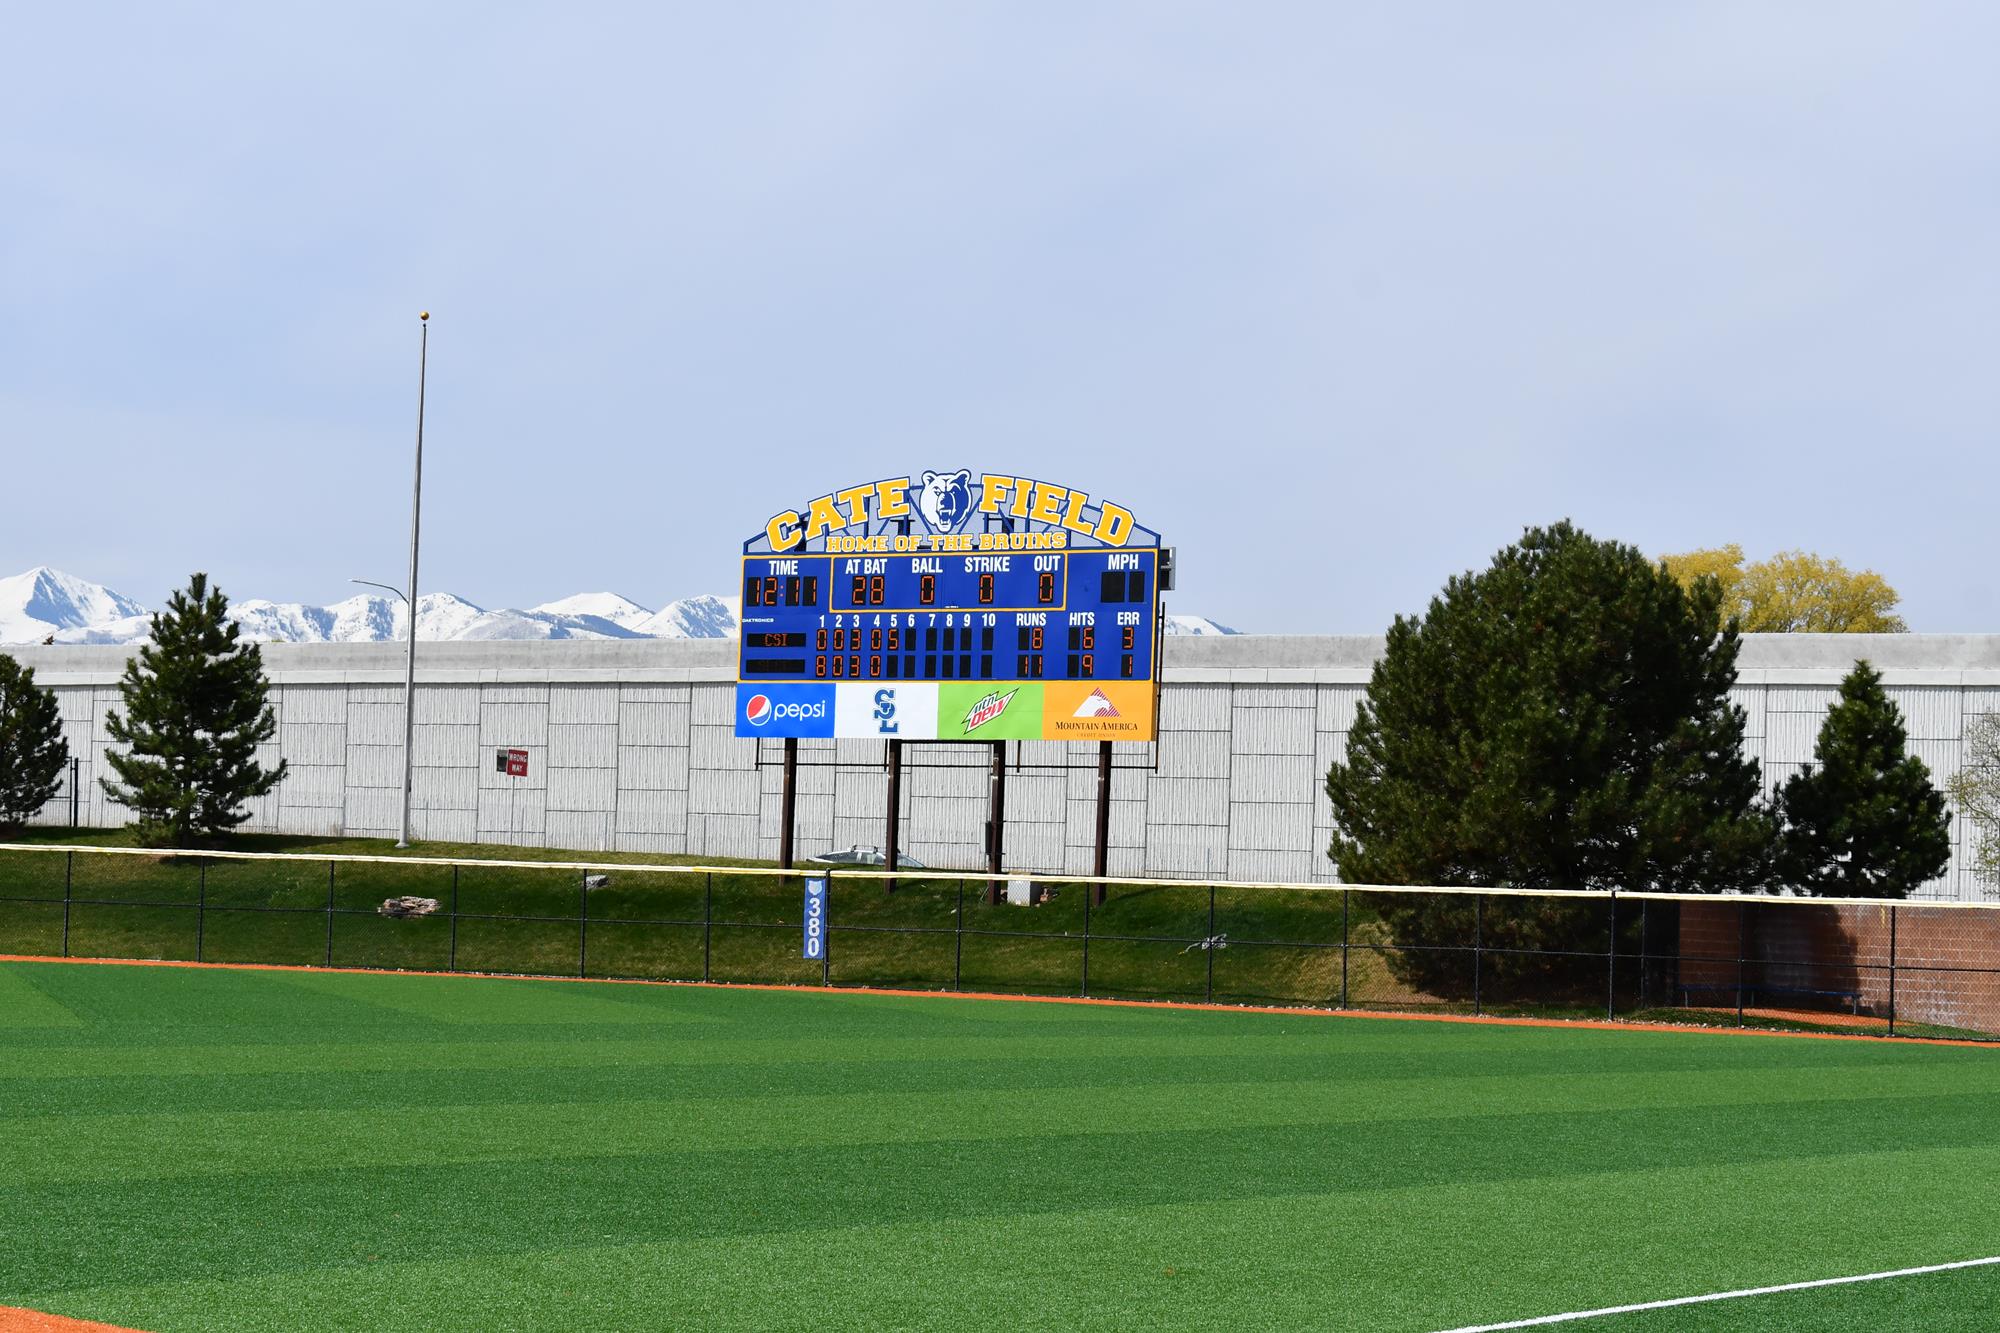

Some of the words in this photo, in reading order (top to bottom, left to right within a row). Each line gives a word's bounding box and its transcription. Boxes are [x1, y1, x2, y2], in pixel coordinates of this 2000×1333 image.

[765, 476, 910, 553] CATE
[978, 473, 1136, 547] FIELD
[826, 535, 889, 552] HOME
[894, 535, 923, 552] OF
[928, 534, 973, 551] THE
[979, 532, 1067, 550] BRUINS
[769, 560, 798, 575] TIME
[845, 559, 861, 574] AT
[863, 559, 887, 574] BAT
[912, 558, 943, 573] BALL
[965, 556, 1010, 572] STRIKE
[1034, 555, 1061, 571] OUT
[1108, 554, 1139, 570] MPH
[755, 577, 817, 604] 12:11
[852, 576, 884, 603] 28
[920, 575, 935, 603] 0
[980, 574, 993, 602] 0
[1039, 573, 1053, 601] 0
[819, 615, 825, 627] 1
[835, 614, 843, 627] 2
[853, 614, 860, 627] 3
[873, 614, 880, 627] 4
[890, 614, 897, 627] 5
[908, 614, 915, 626] 6
[929, 614, 936, 626] 7
[946, 614, 953, 626] 8
[964, 614, 971, 626] 9
[982, 614, 996, 626] 10
[1016, 613, 1047, 626] RUNS
[1069, 613, 1095, 625] HITS
[1117, 612, 1140, 625] ERR
[764, 633, 788, 647] CSI
[817, 629, 827, 650] 0
[834, 629, 844, 650] 0
[852, 629, 860, 650] 3
[871, 629, 881, 650] 0
[888, 628, 898, 649] 5
[1032, 628, 1043, 649] 8
[1083, 627, 1094, 649] 6
[1124, 627, 1134, 649] 3
[816, 655, 826, 676] 8
[833, 655, 843, 676] 0
[851, 655, 860, 676] 3
[870, 655, 881, 676] 0
[1025, 655, 1043, 675] 11
[1082, 654, 1093, 675] 9
[774, 700, 826, 721] pepsi
[808, 897, 820, 957] 380
